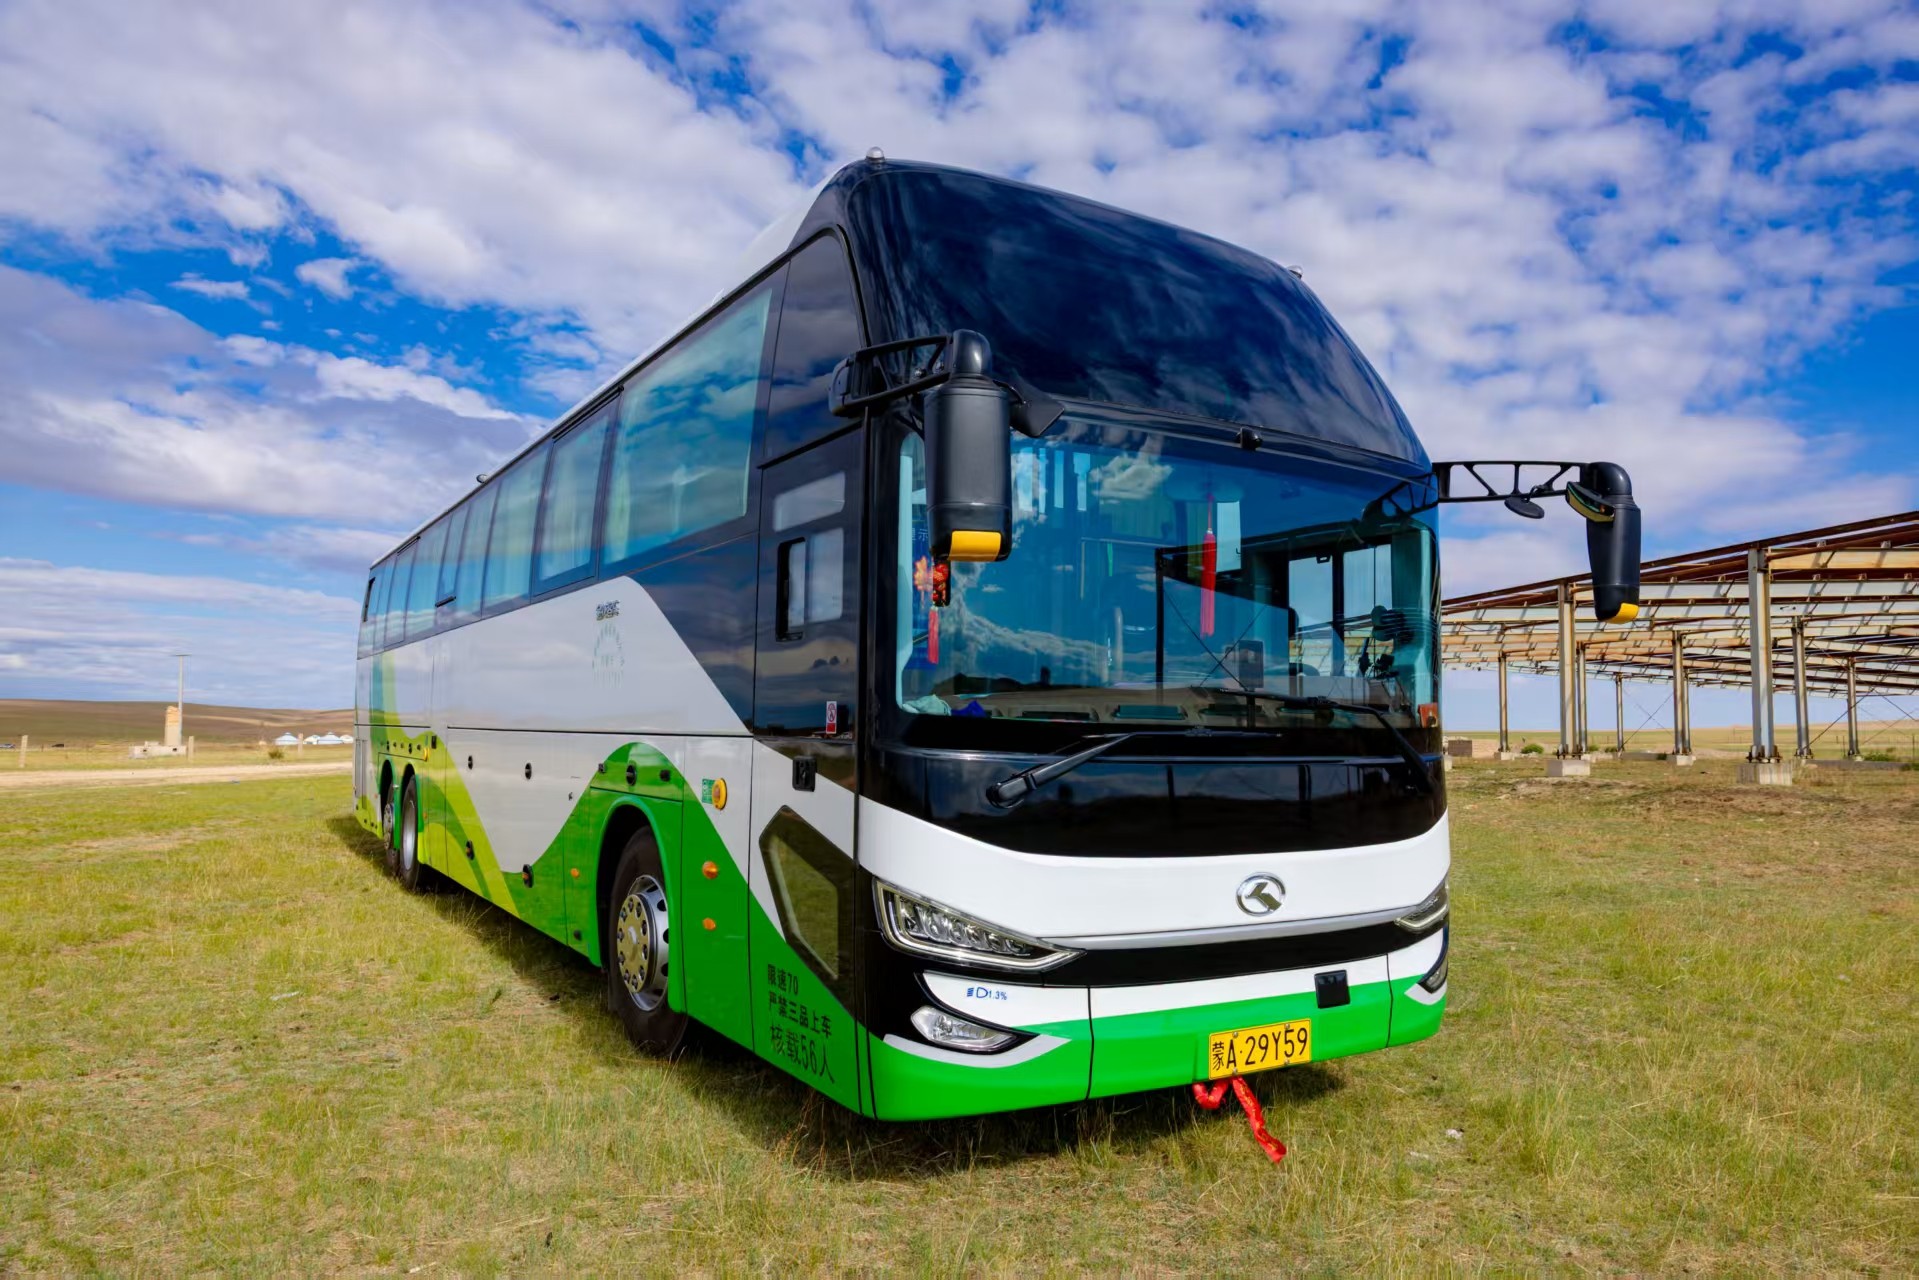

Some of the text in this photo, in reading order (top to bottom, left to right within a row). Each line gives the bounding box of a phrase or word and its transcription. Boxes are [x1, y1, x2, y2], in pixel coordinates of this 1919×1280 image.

[767, 963, 799, 995] 限速70
[988, 990, 1008, 1001] 1.3%
[768, 990, 832, 1039] 严禁三品上车
[770, 1020, 835, 1084] 核载56人
